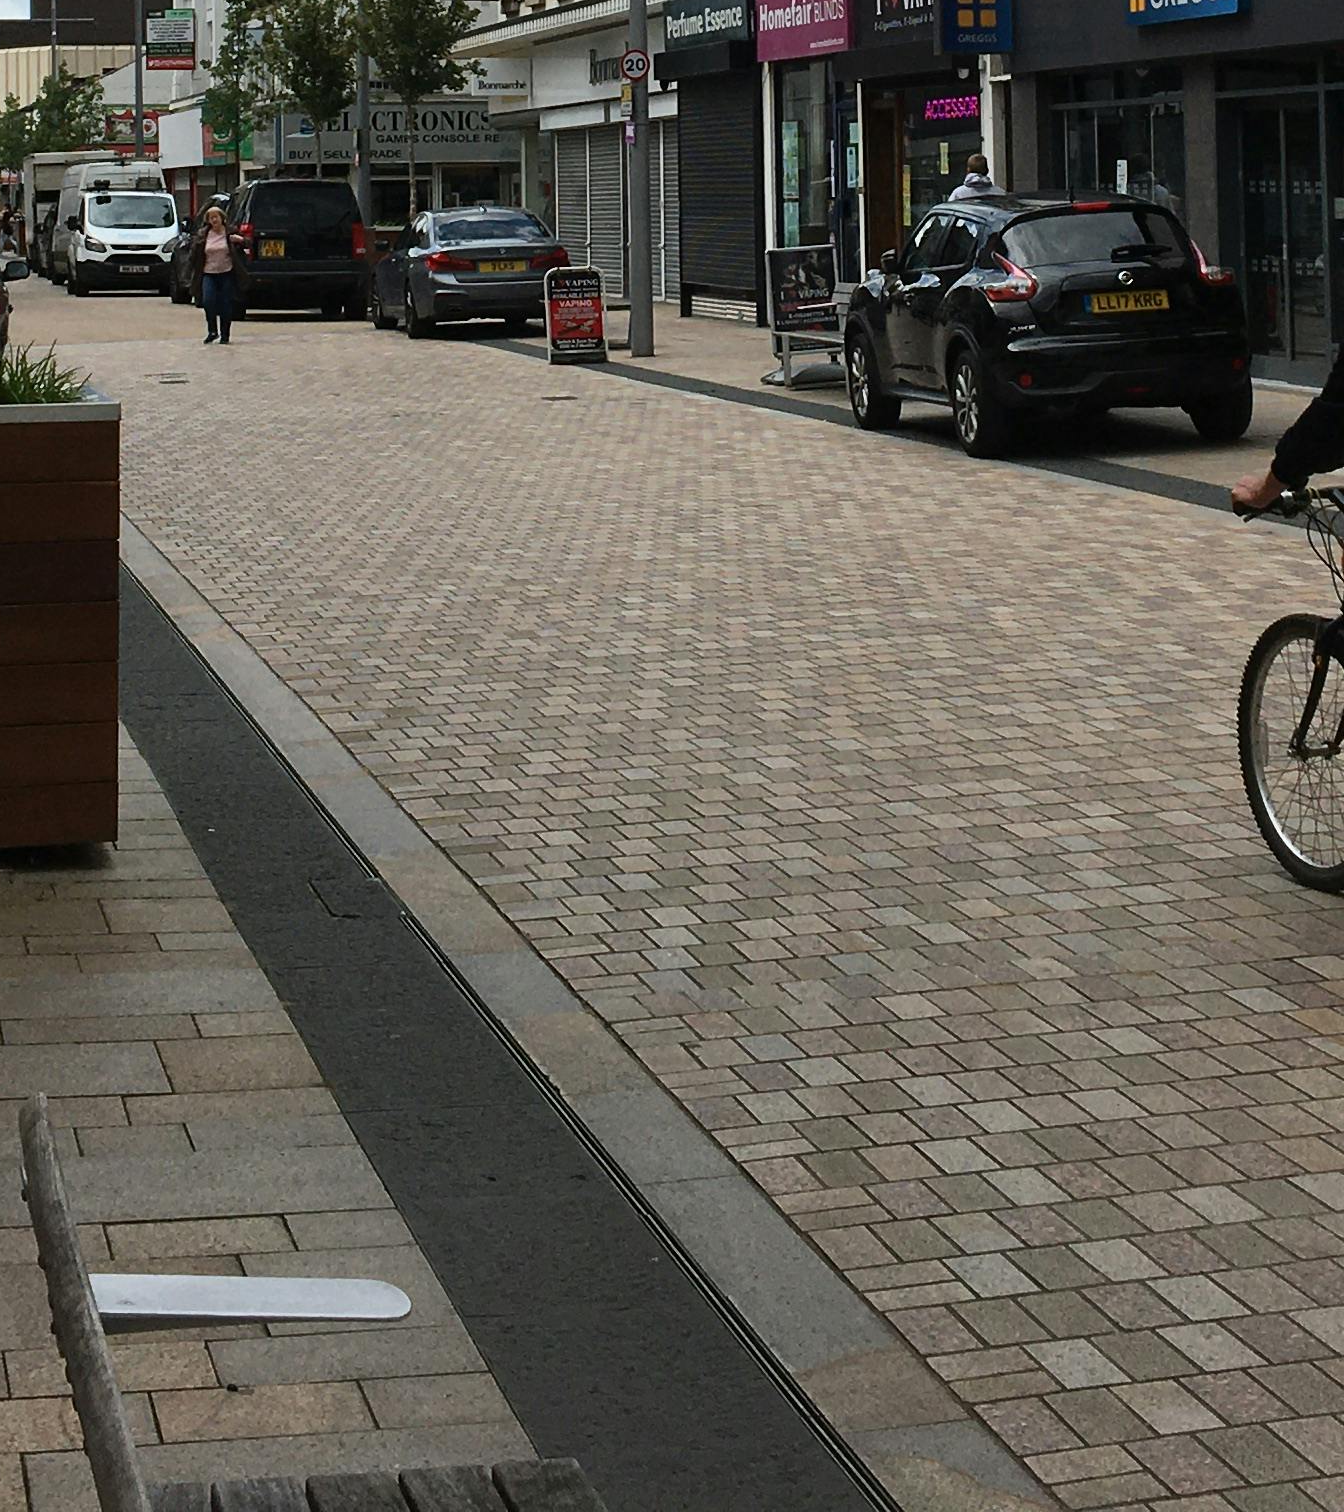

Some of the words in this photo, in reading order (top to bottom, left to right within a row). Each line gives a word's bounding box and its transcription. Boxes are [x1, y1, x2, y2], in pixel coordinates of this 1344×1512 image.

[666, 11, 704, 40] Perfume
[705, 5, 743, 33] Essence
[958, 33, 999, 44] GREGGS
[624, 58, 646, 72] 20
[326, 109, 490, 132] ELCTRONICS
[375, 133, 420, 144] GAMES
[422, 133, 481, 144] CONSOLE
[288, 150, 313, 160] BUY
[323, 149, 352, 160] SELL
[369, 149, 402, 159] RADE
[565, 278, 599, 287] VAPING
[798, 287, 830, 300] VAPING
[559, 299, 593, 308] VAPING
[1096, 294, 1131, 311] LL17
[1133, 292, 1164, 309] KRG
